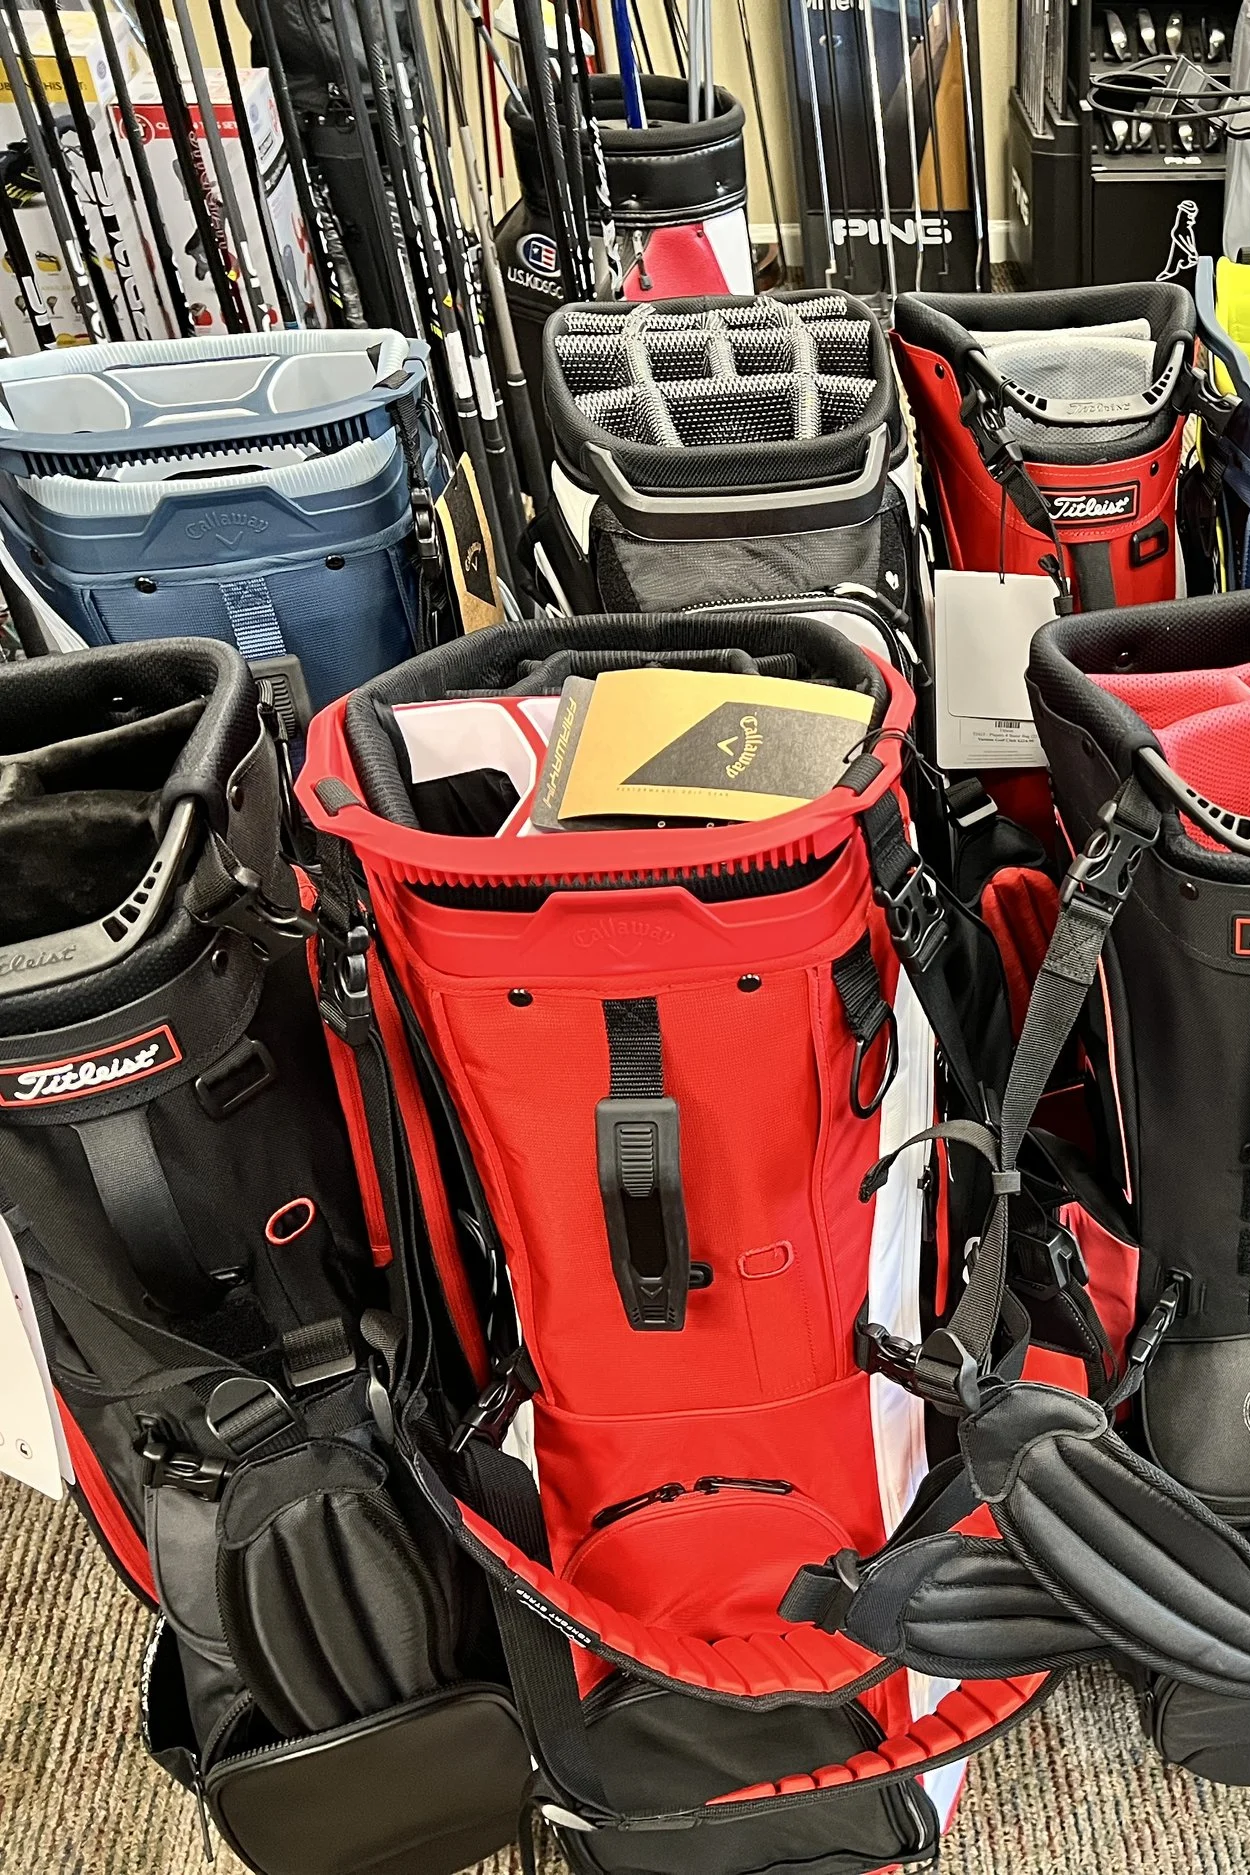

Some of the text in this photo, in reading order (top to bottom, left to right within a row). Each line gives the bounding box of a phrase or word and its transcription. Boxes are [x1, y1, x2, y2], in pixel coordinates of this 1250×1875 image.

[832, 218, 953, 246] PING
[1048, 496, 1130, 519] Titleist
[185, 511, 269, 539] Callaway
[726, 714, 764, 779] Callaway
[572, 917, 676, 948] Callaway
[14, 1043, 160, 1101] Titleist
